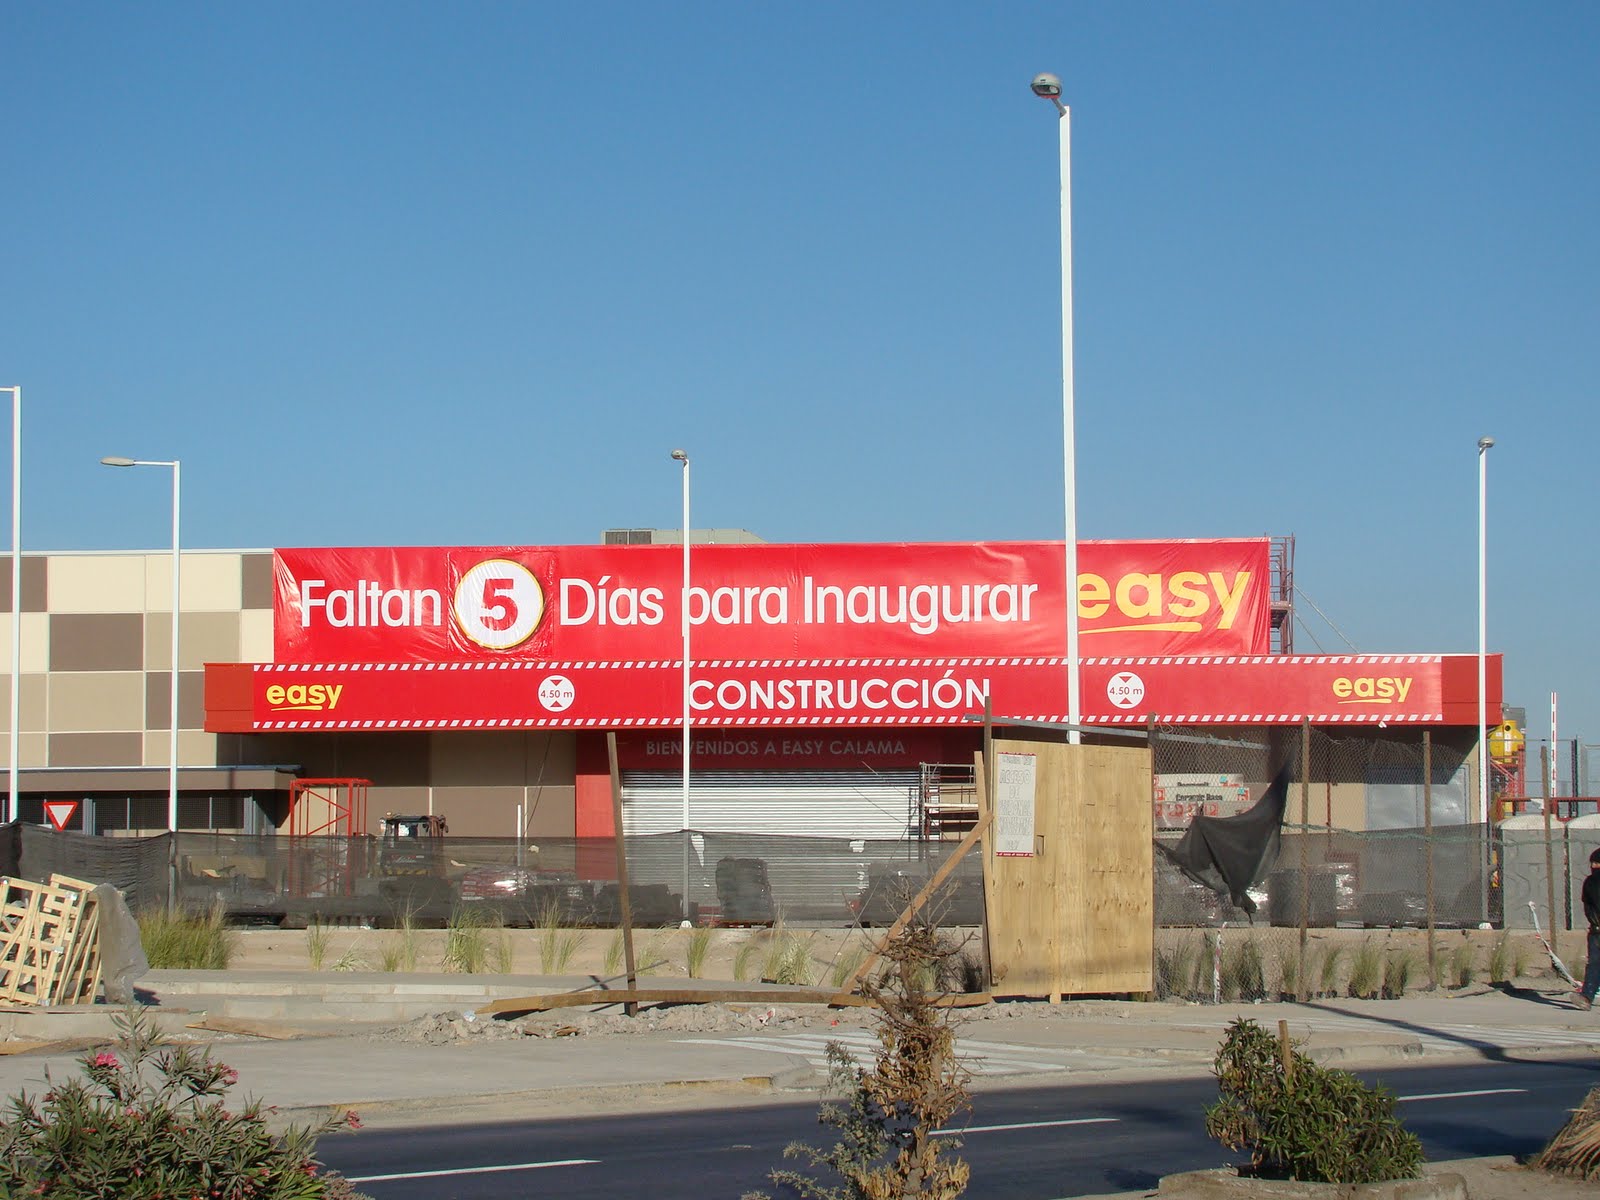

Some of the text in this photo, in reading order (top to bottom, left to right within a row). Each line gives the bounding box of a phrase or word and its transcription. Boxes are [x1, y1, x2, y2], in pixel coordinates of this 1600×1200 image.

[300, 571, 1251, 637] Faltan 5 Días para Inaugurar easy
[266, 684, 343, 709] easy
[540, 689, 561, 698] 4.50
[689, 669, 990, 710] CONSTRUCCIÓN
[1109, 686, 1130, 695] 4.50
[1332, 677, 1413, 702] easy
[763, 741, 777, 755] A
[782, 741, 824, 755] EASY
[829, 740, 906, 755] CALAMA
